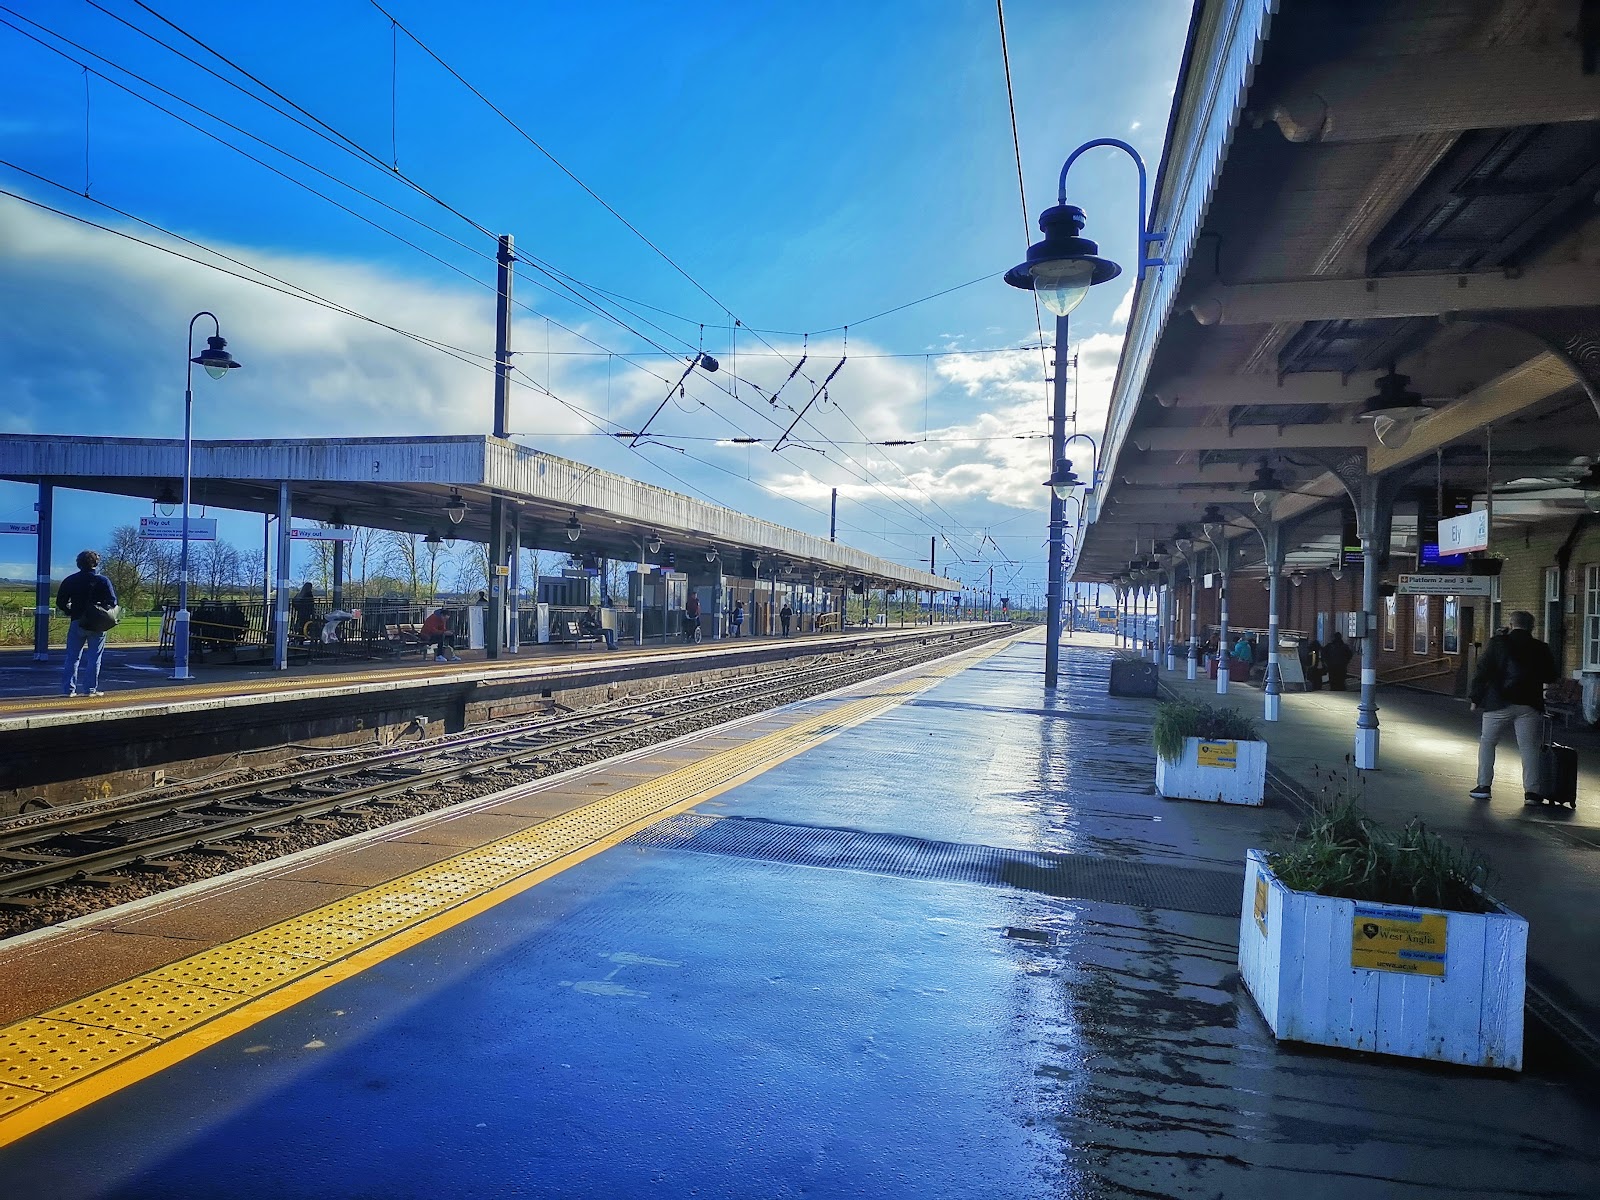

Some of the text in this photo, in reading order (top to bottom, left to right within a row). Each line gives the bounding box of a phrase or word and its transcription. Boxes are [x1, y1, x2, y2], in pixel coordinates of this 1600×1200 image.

[1451, 525, 1462, 545] Ely
[1380, 932, 1436, 946] West Anglia
